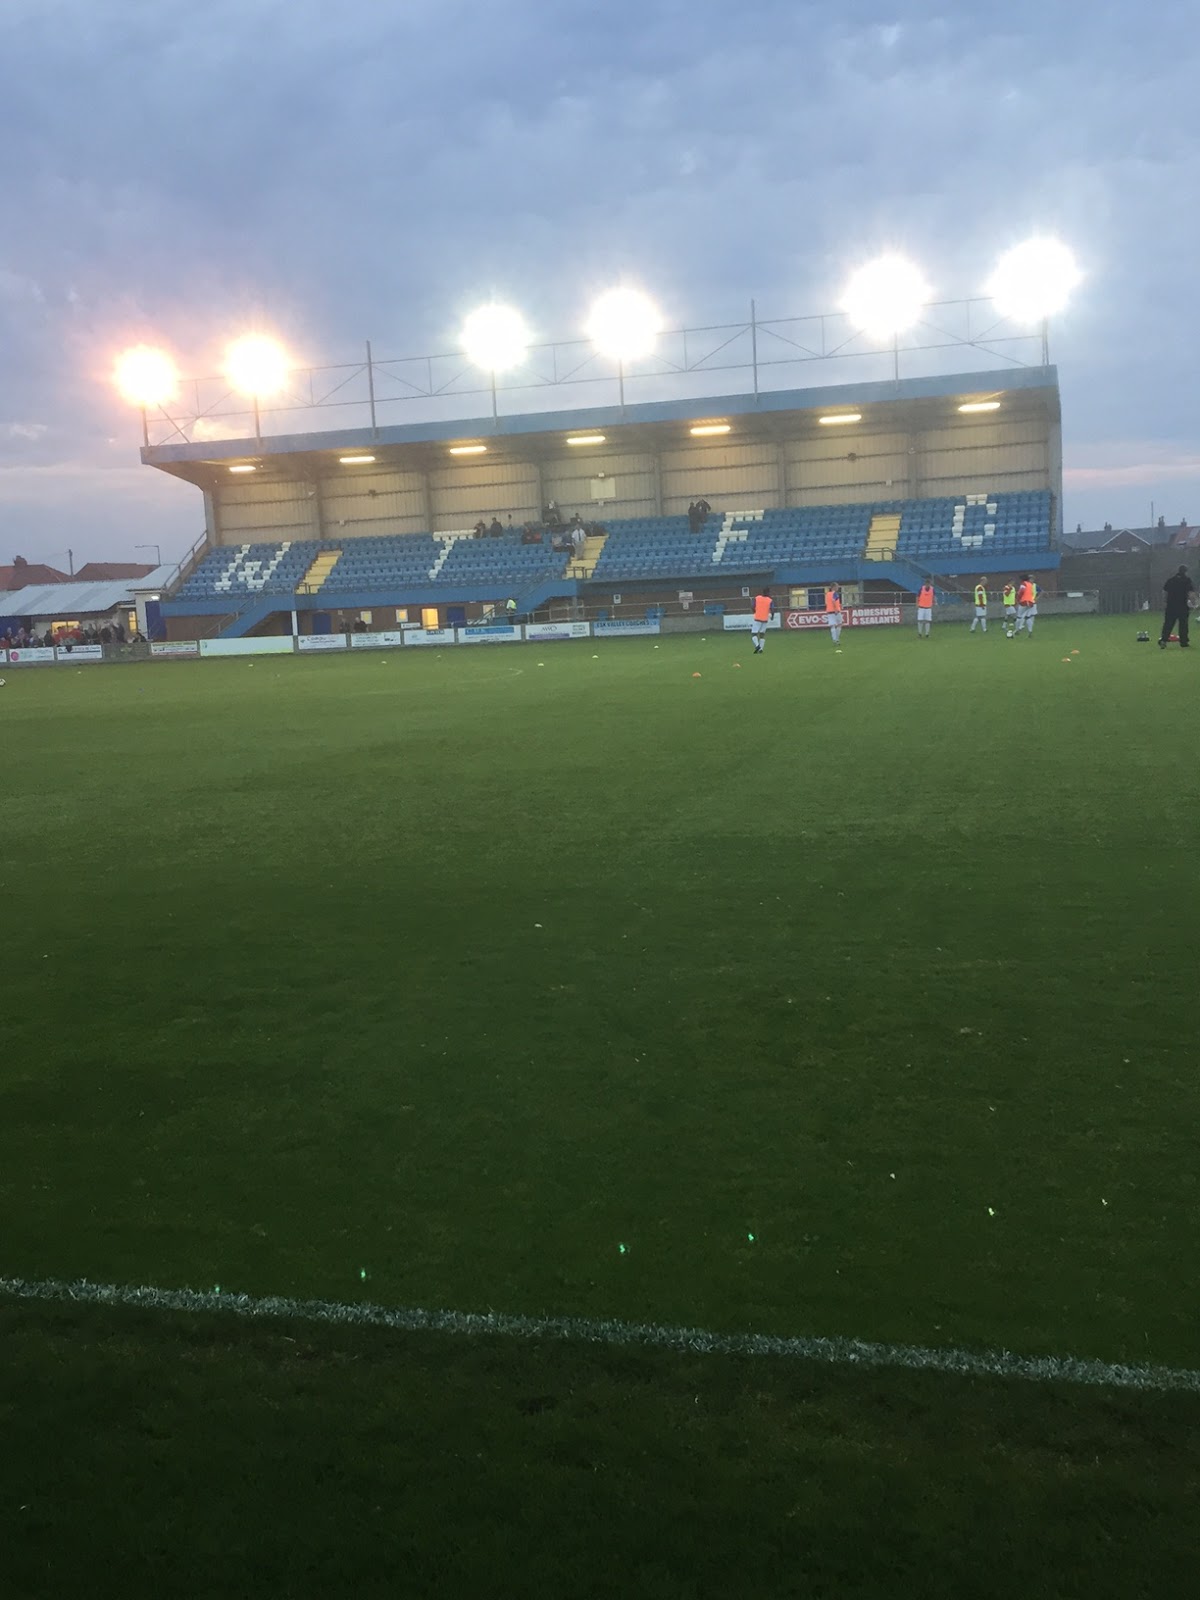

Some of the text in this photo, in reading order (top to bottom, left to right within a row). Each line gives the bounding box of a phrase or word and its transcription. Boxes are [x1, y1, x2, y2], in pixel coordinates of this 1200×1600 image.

[428, 528, 478, 581] T
[712, 509, 765, 562] F
[952, 494, 997, 547] C
[852, 607, 900, 617] ADHESIVES
[852, 615, 900, 625] & SEALANTS
